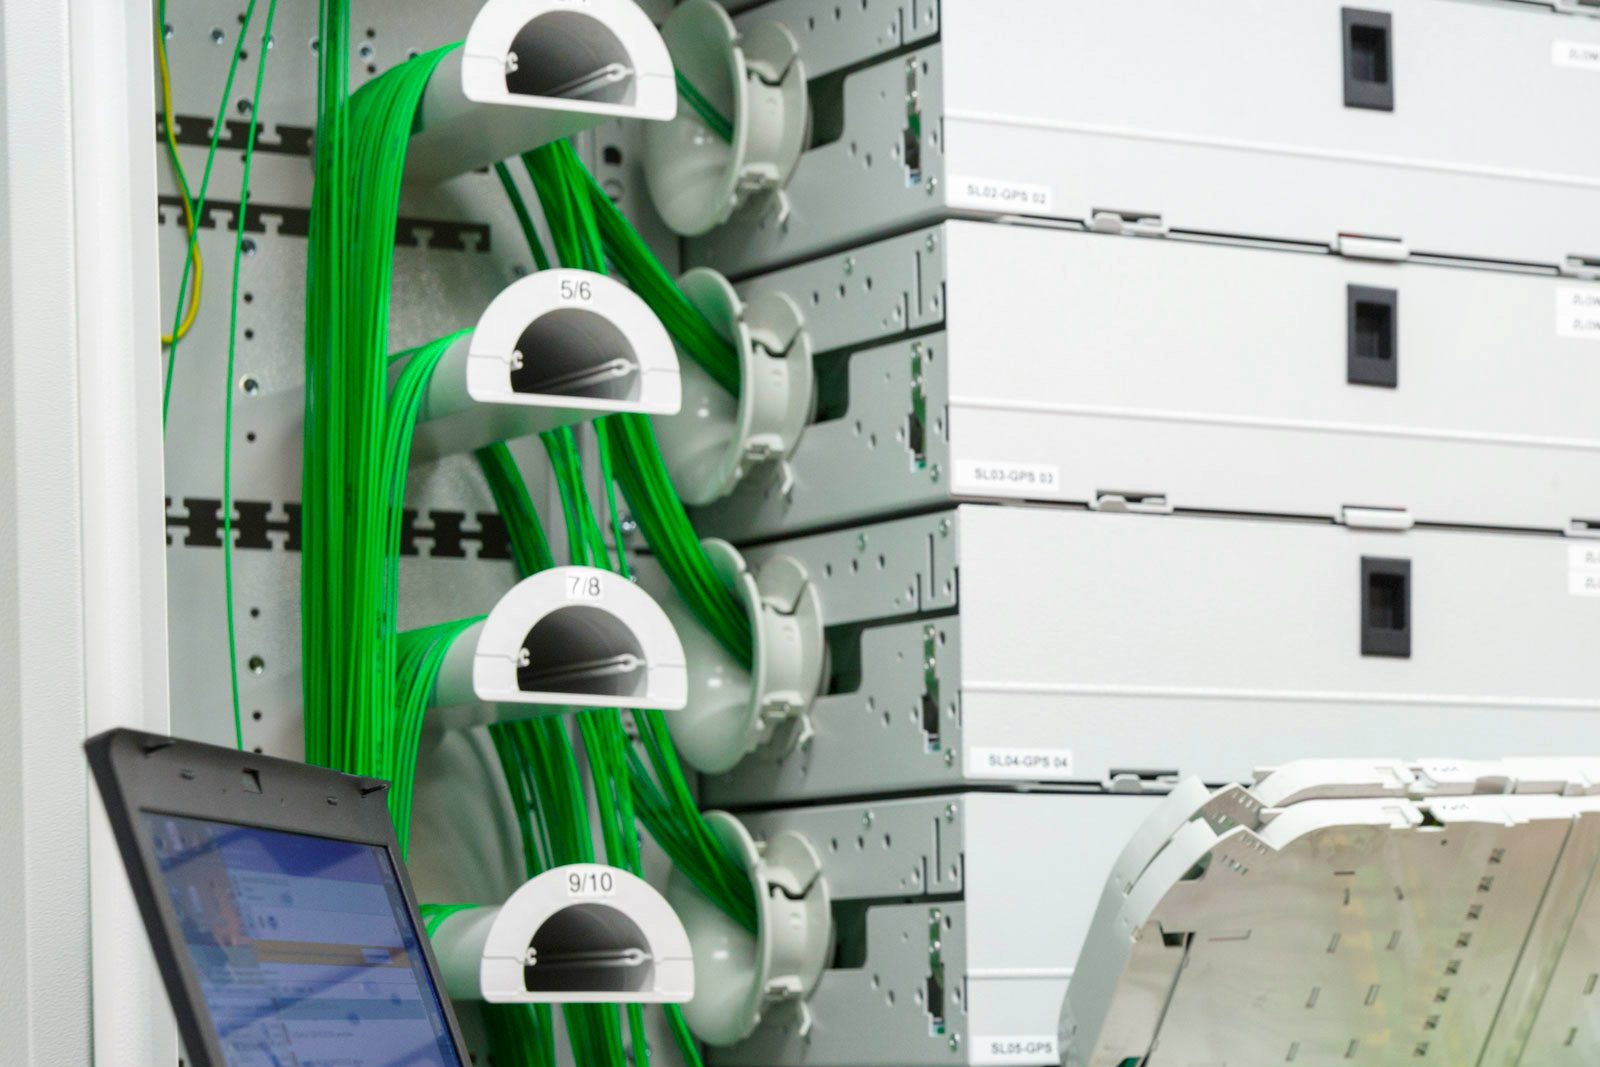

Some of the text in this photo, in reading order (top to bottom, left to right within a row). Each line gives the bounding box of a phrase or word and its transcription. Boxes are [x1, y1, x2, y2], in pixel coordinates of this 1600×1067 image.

[560, 279, 592, 301] 5/6
[975, 467, 1036, 484] SL03-GPS
[568, 576, 600, 597] 7/8
[988, 753, 1068, 769] SL04-GPS 04
[568, 872, 613, 893] 9/10
[991, 1041, 1052, 1055] SL05-GPS
